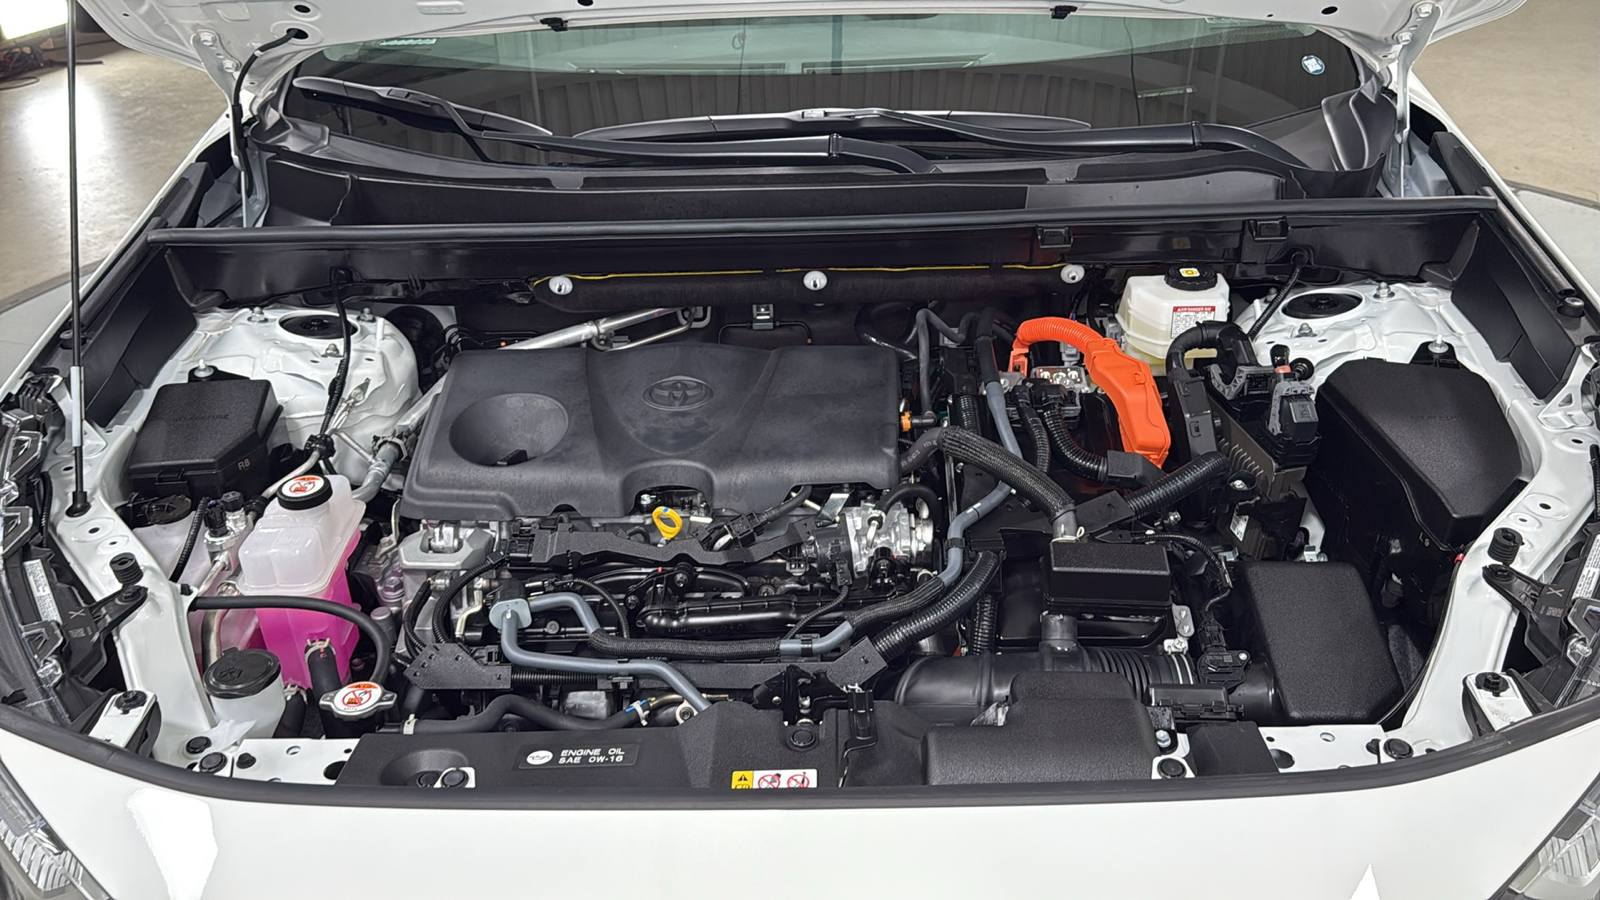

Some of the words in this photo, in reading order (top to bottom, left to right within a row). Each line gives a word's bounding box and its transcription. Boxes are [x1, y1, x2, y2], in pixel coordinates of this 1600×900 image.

[237, 458, 251, 471] R8
[560, 748, 602, 757] ENGINE
[608, 747, 625, 755] OIL
[558, 756, 582, 764] SAE
